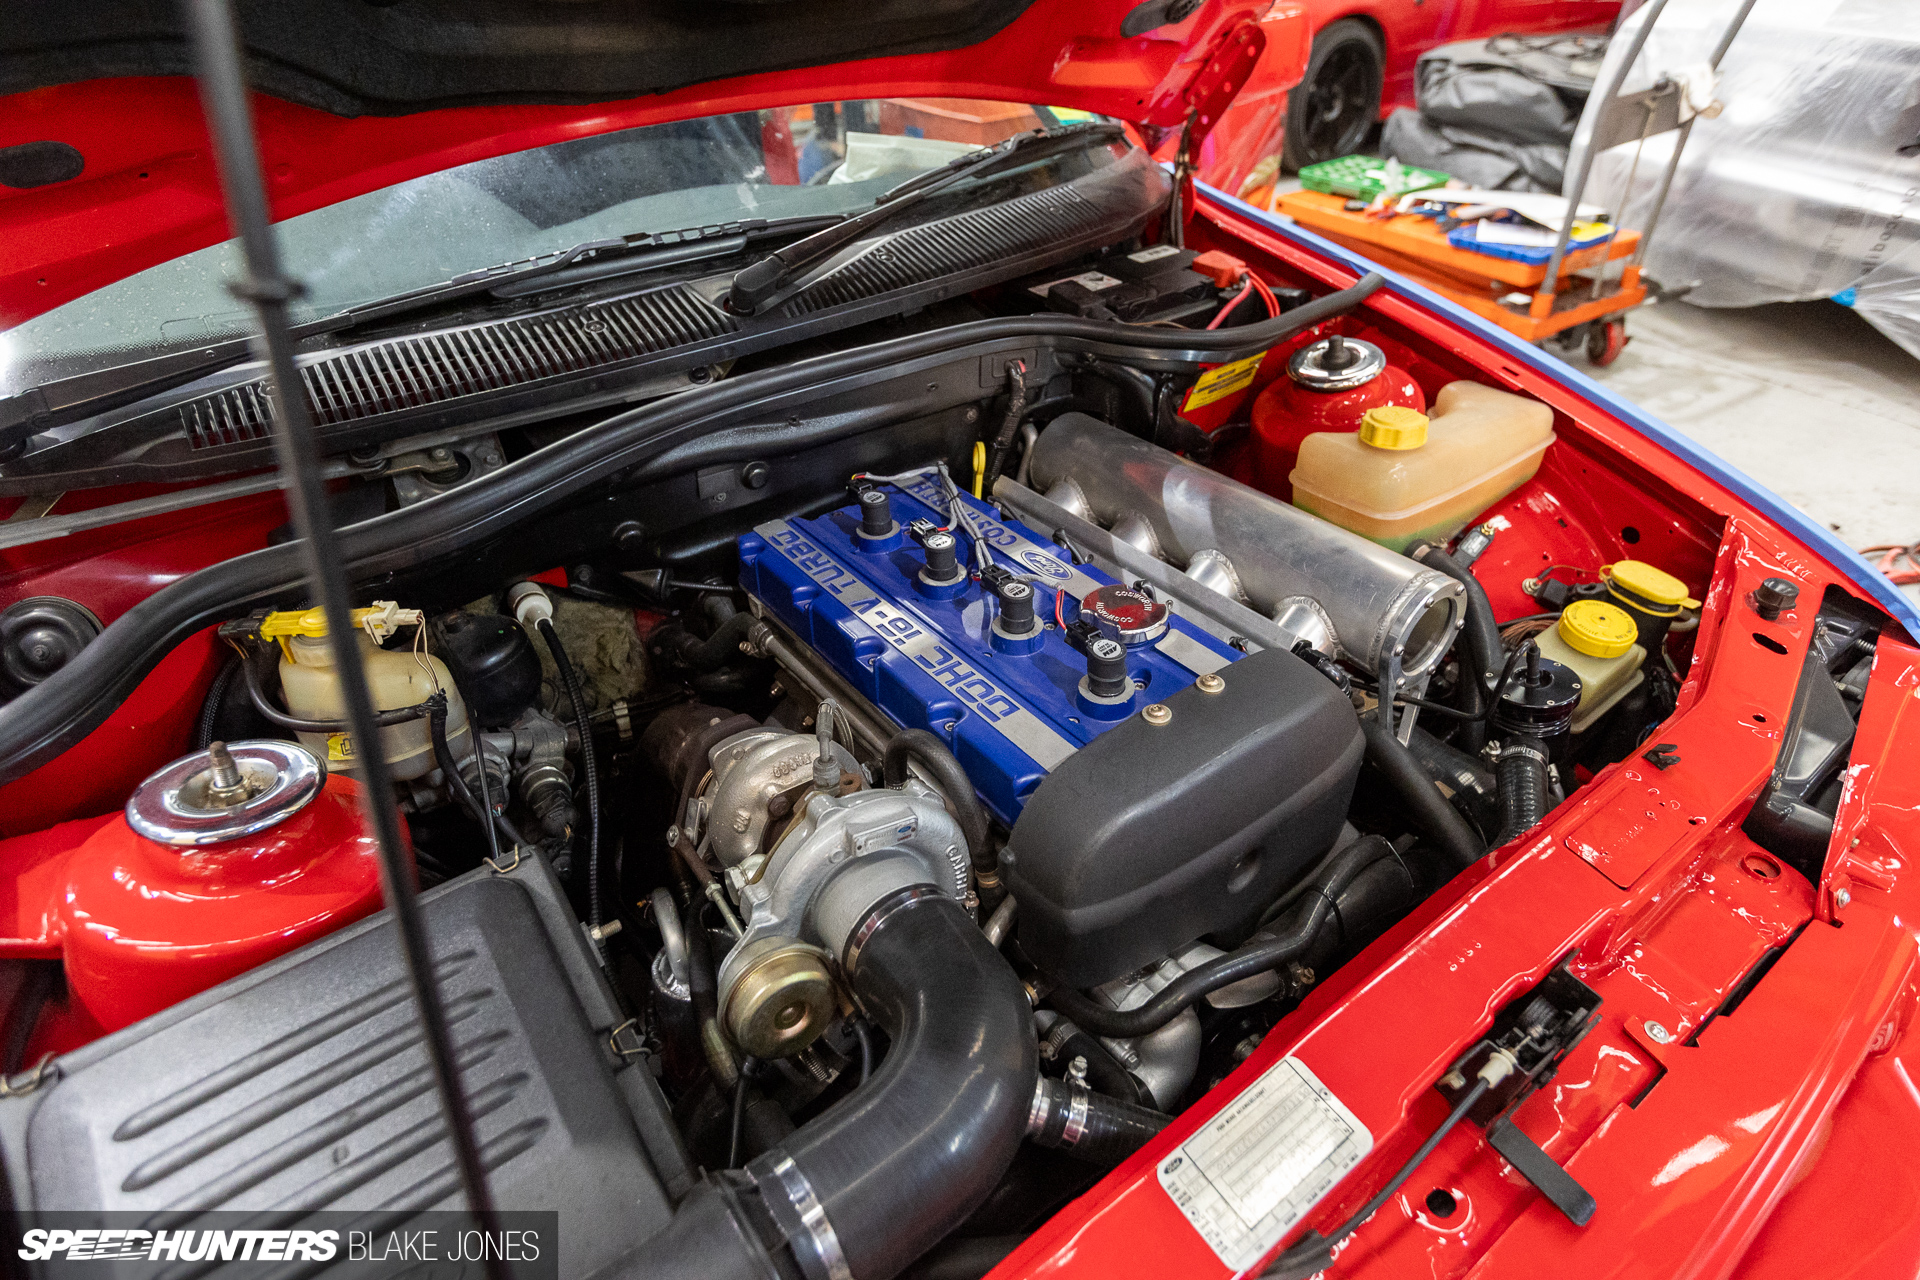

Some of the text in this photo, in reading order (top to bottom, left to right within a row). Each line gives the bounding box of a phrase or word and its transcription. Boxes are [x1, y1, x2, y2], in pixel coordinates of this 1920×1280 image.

[908, 481, 1017, 546] COSWRTH
[768, 530, 857, 595] TURBO
[1028, 554, 1065, 576] Ford
[1013, 587, 1026, 597] AEM
[1115, 590, 1153, 612] COSWORTH
[1095, 601, 1134, 623] COSWORTH
[1103, 645, 1117, 657] AEM
[914, 645, 1020, 723] DOHC
